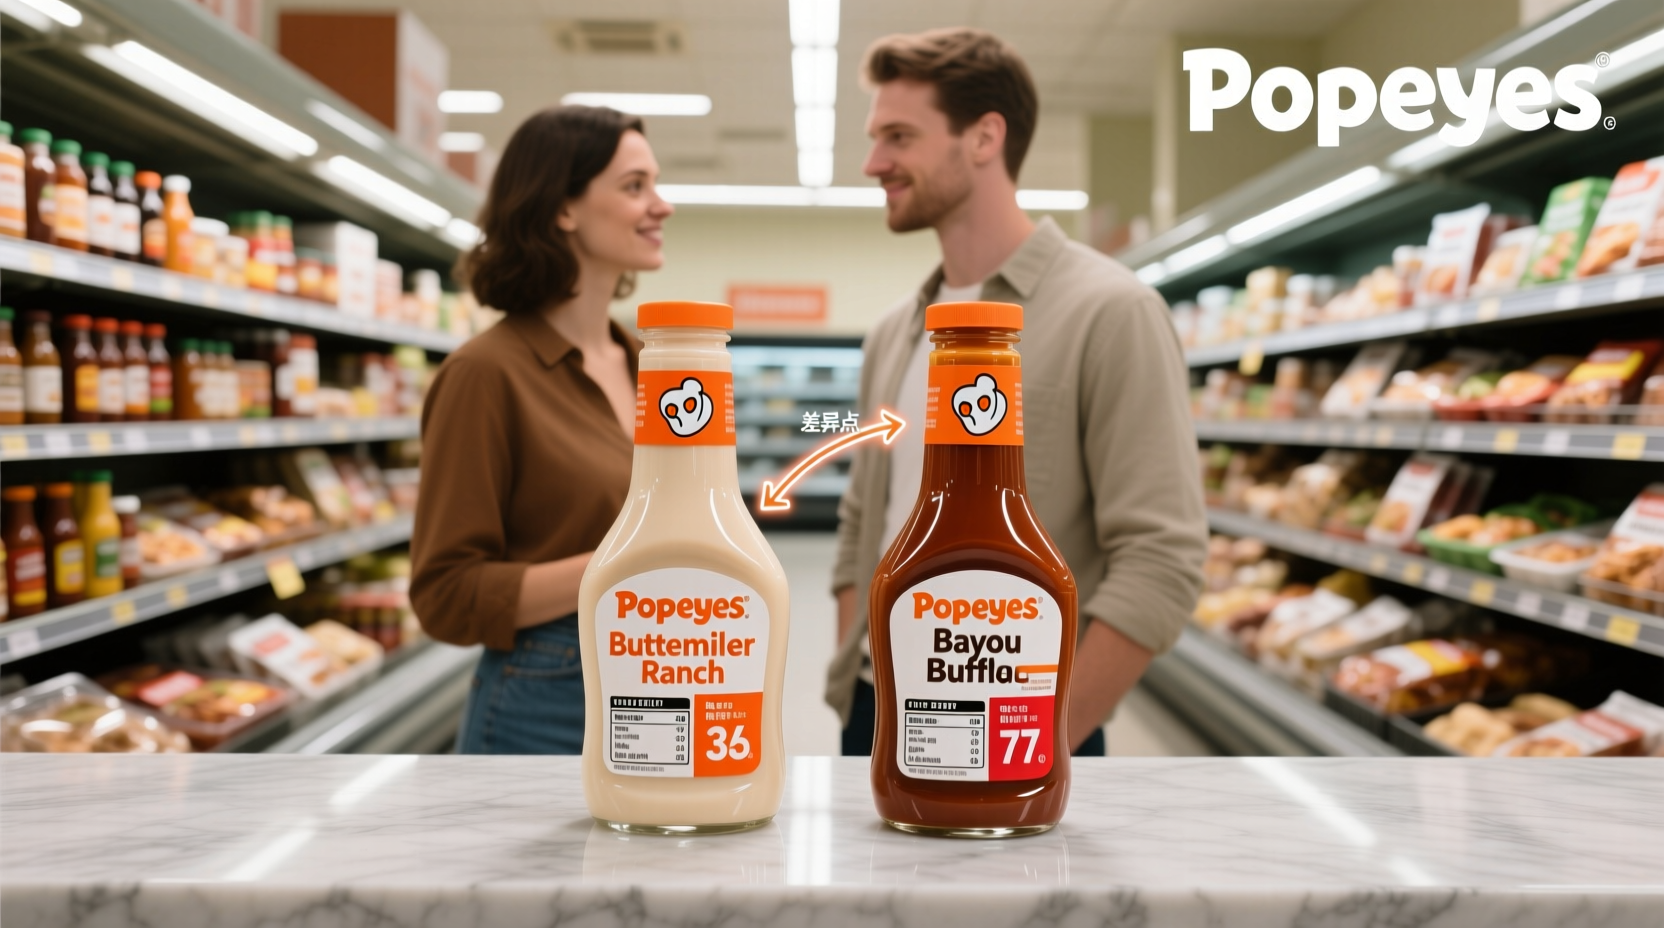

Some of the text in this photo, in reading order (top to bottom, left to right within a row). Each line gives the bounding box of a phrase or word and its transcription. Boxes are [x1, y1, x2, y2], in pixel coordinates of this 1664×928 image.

[615, 590, 745, 626] Popeyes
[912, 591, 1039, 625] Popeyes
[609, 630, 756, 657] Buttemiler
[933, 627, 1022, 660] Bayou
[641, 658, 725, 685] Ranch
[705, 724, 751, 762] 36
[999, 728, 1041, 765] 77
